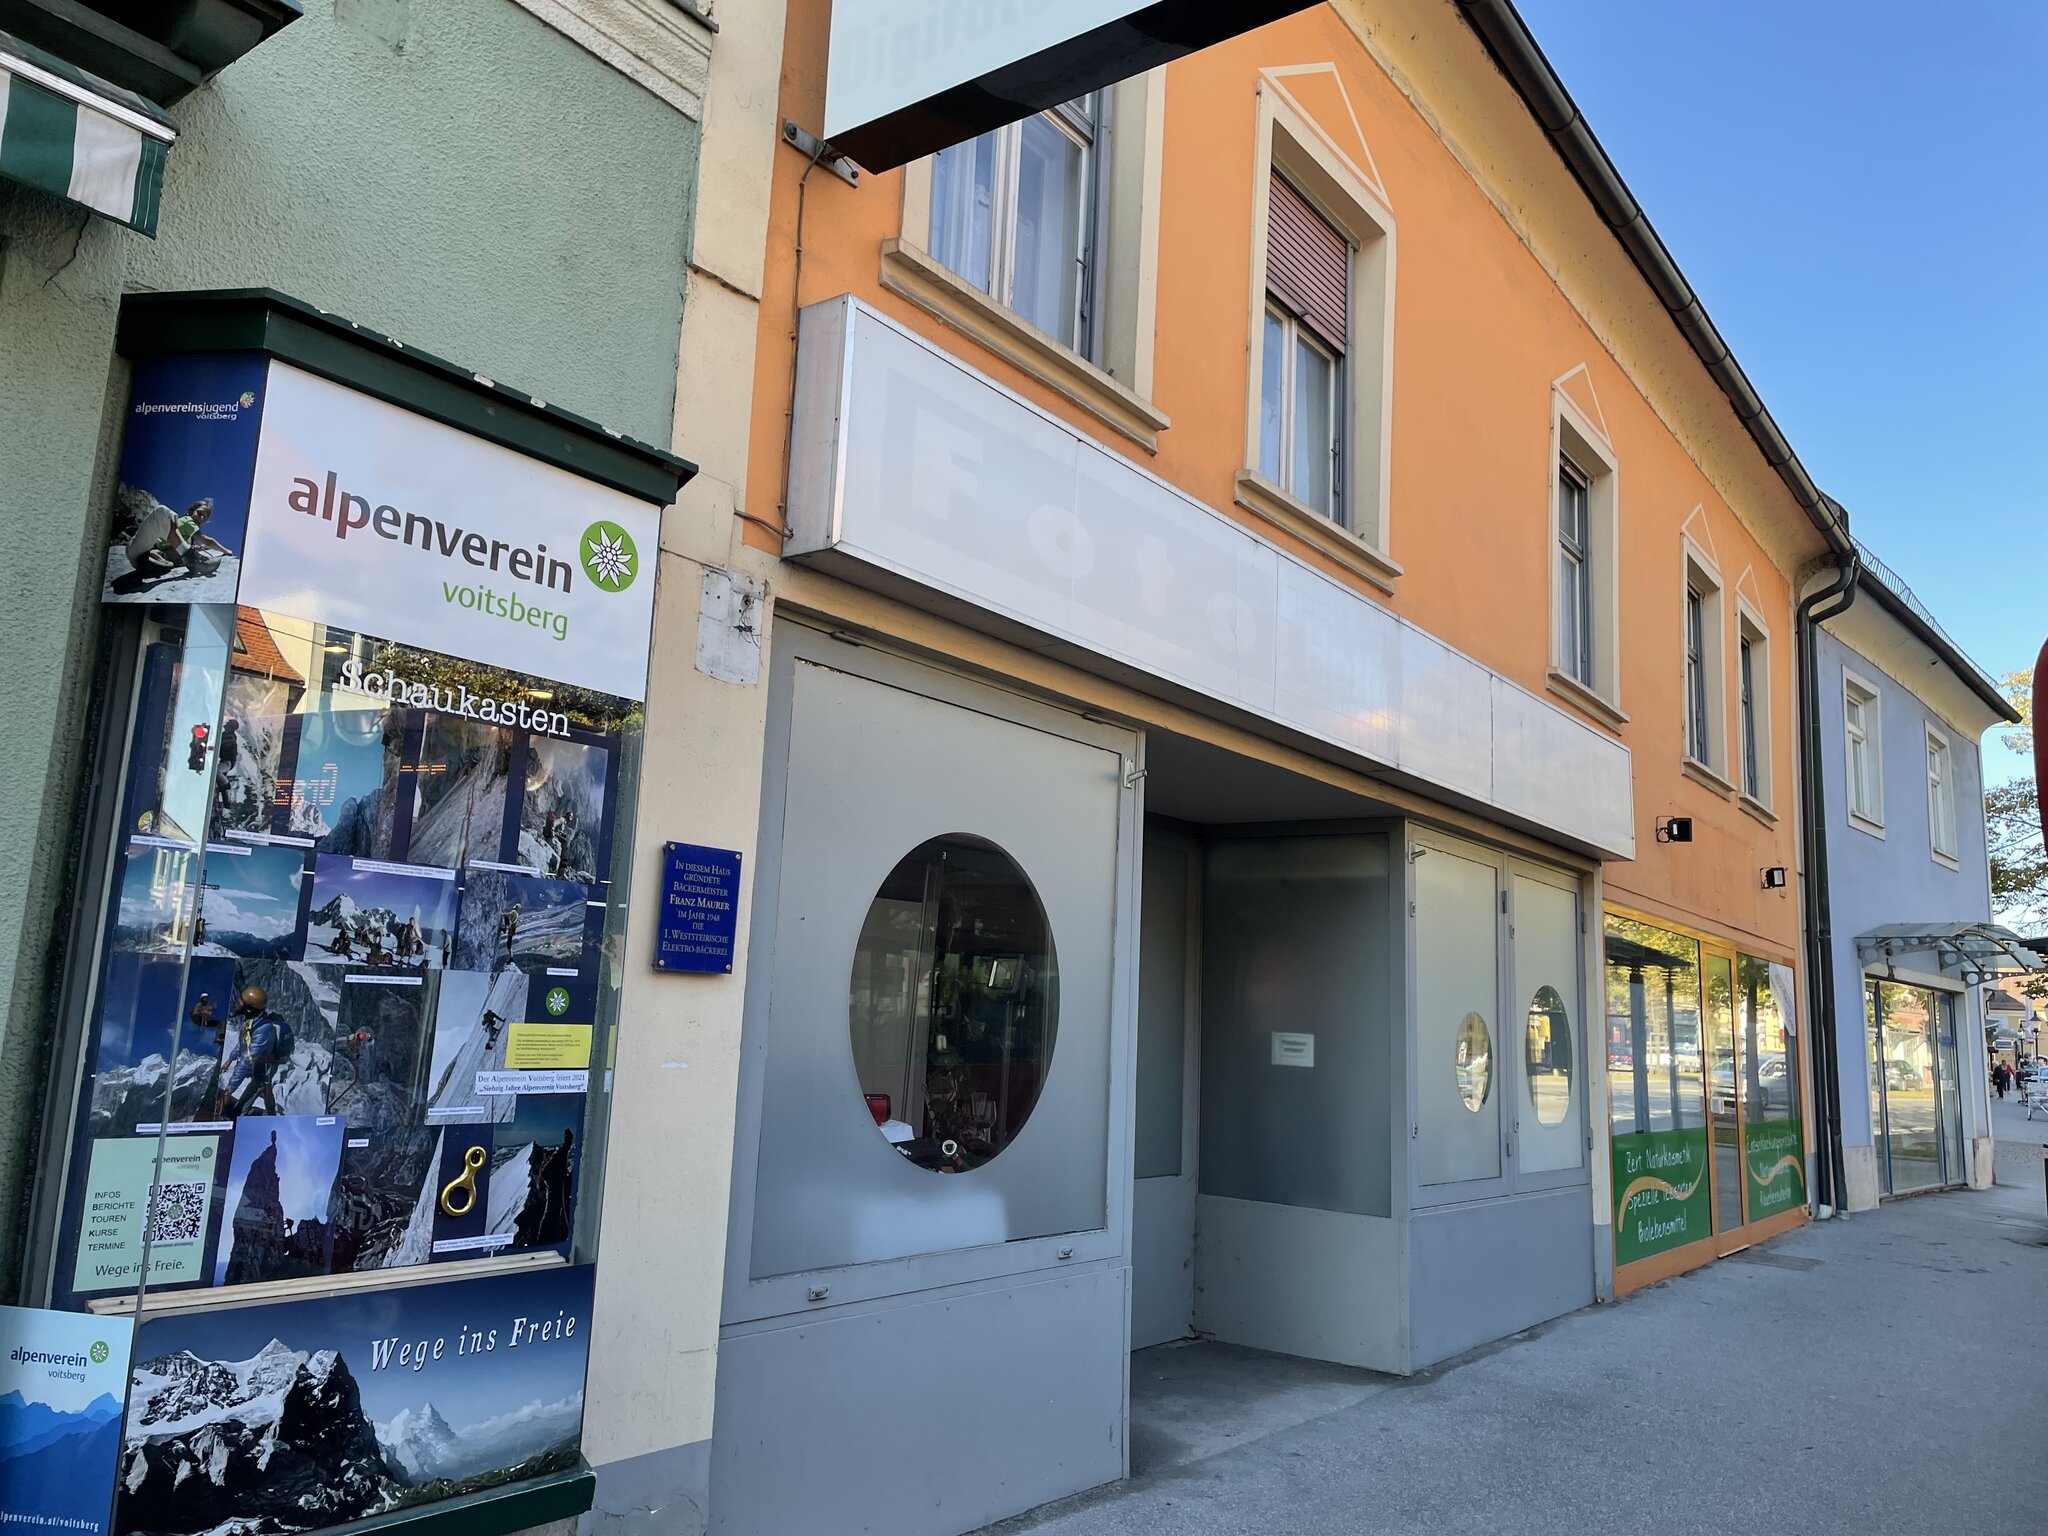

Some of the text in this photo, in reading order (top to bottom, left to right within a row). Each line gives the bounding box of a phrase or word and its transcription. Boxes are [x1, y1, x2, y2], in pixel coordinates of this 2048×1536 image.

[135, 400, 239, 415] alpenvereinsjugend
[195, 413, 238, 421] voitsberg
[287, 470, 573, 593] alpenverein
[442, 580, 569, 641] voitsberg
[339, 659, 572, 738] Schaukasten
[94, 1190, 121, 1199] INFOS
[92, 1201, 135, 1211] BERICHTE
[91, 1214, 127, 1223] TOUREN
[88, 1228, 119, 1237] KURSE
[88, 1241, 126, 1251] TERMINE
[95, 1264, 130, 1277] Wege
[154, 1259, 185, 1271] Freie.
[371, 1310, 576, 1372] Wege ins Freie
[10, 1346, 88, 1368] alpenverein
[48, 1369, 86, 1383] voitsberg
[0, 1510, 99, 1533] lpenverein.at/voitsberg
